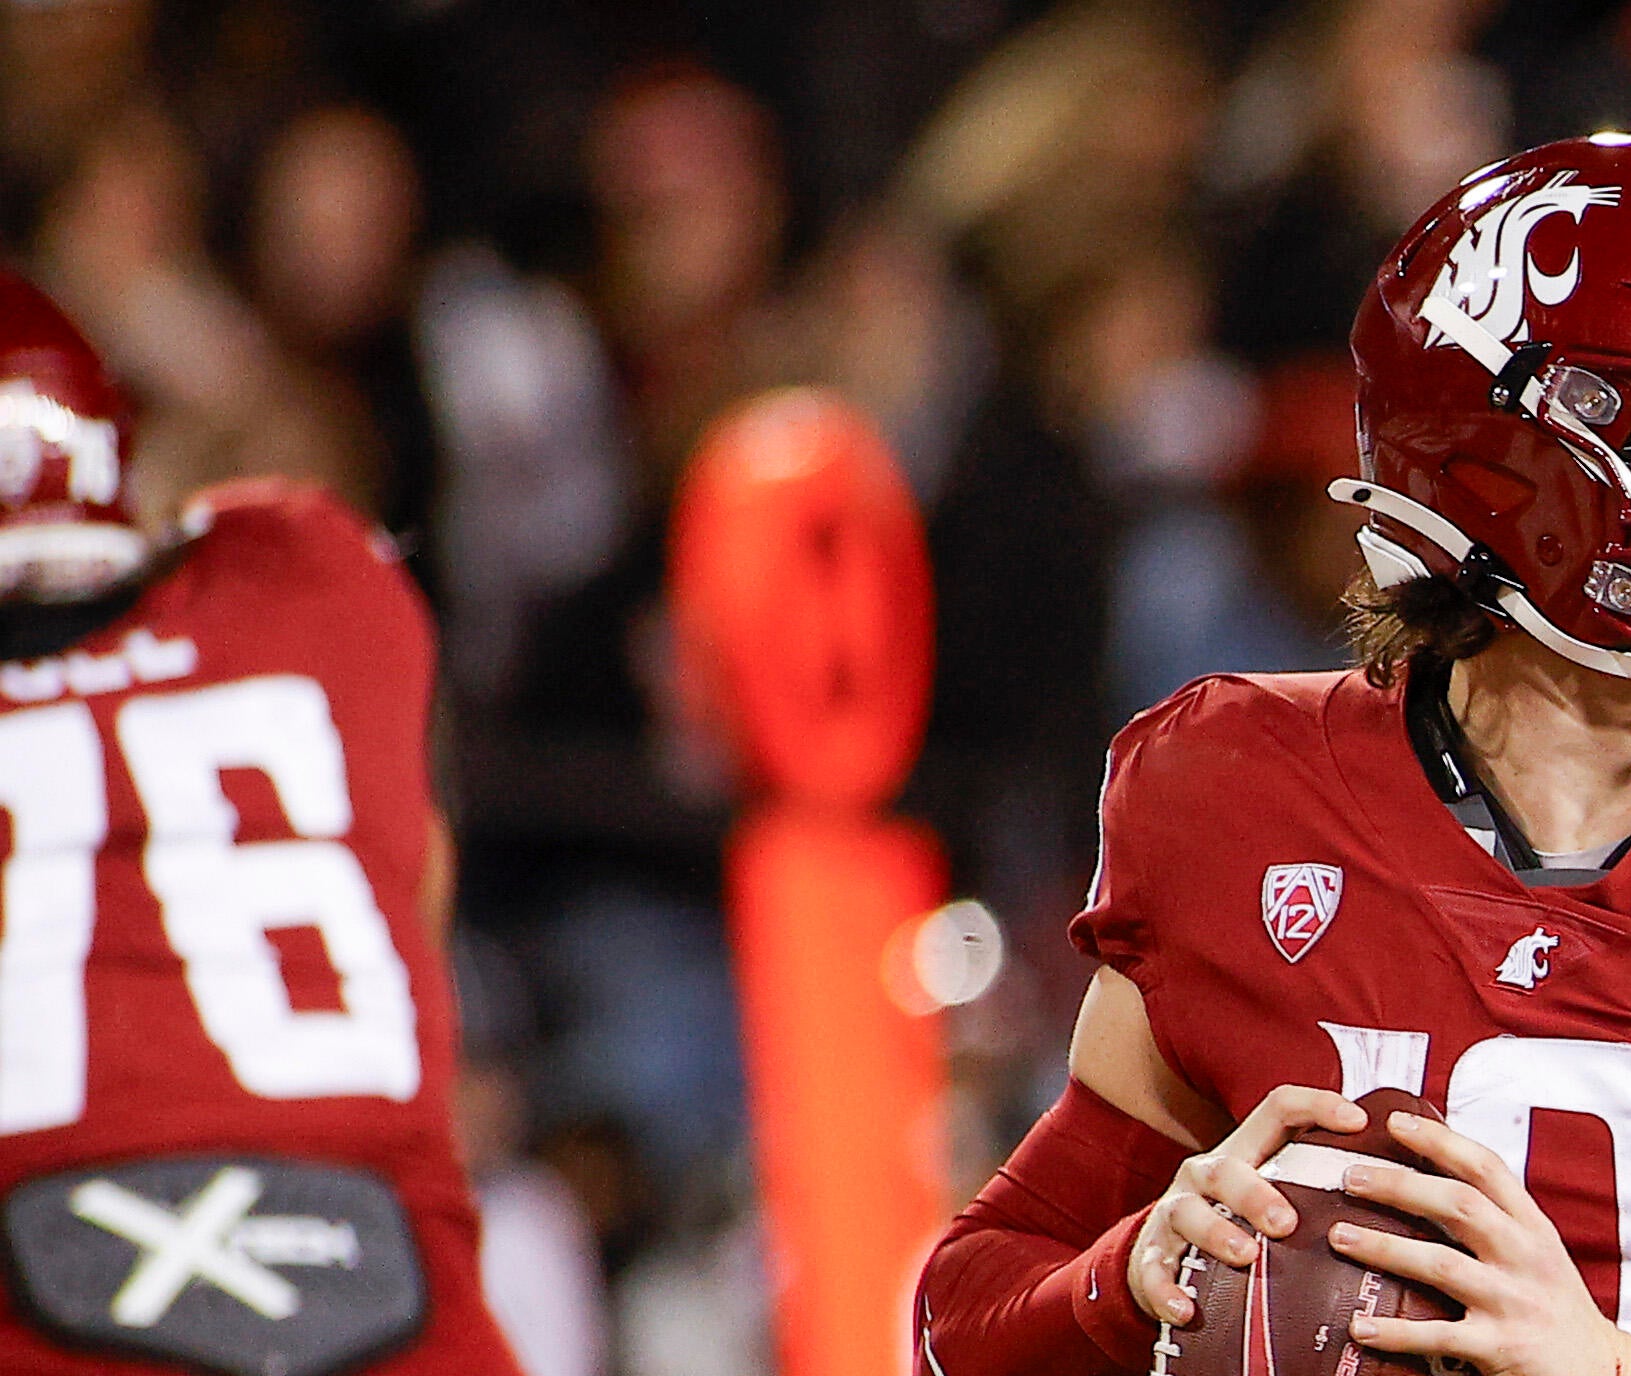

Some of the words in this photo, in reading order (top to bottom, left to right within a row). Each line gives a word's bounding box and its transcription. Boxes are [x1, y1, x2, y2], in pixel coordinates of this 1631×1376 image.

[0, 674, 421, 1137] 76
[1263, 865, 1342, 923] PAC
[1277, 903, 1316, 940] 12
